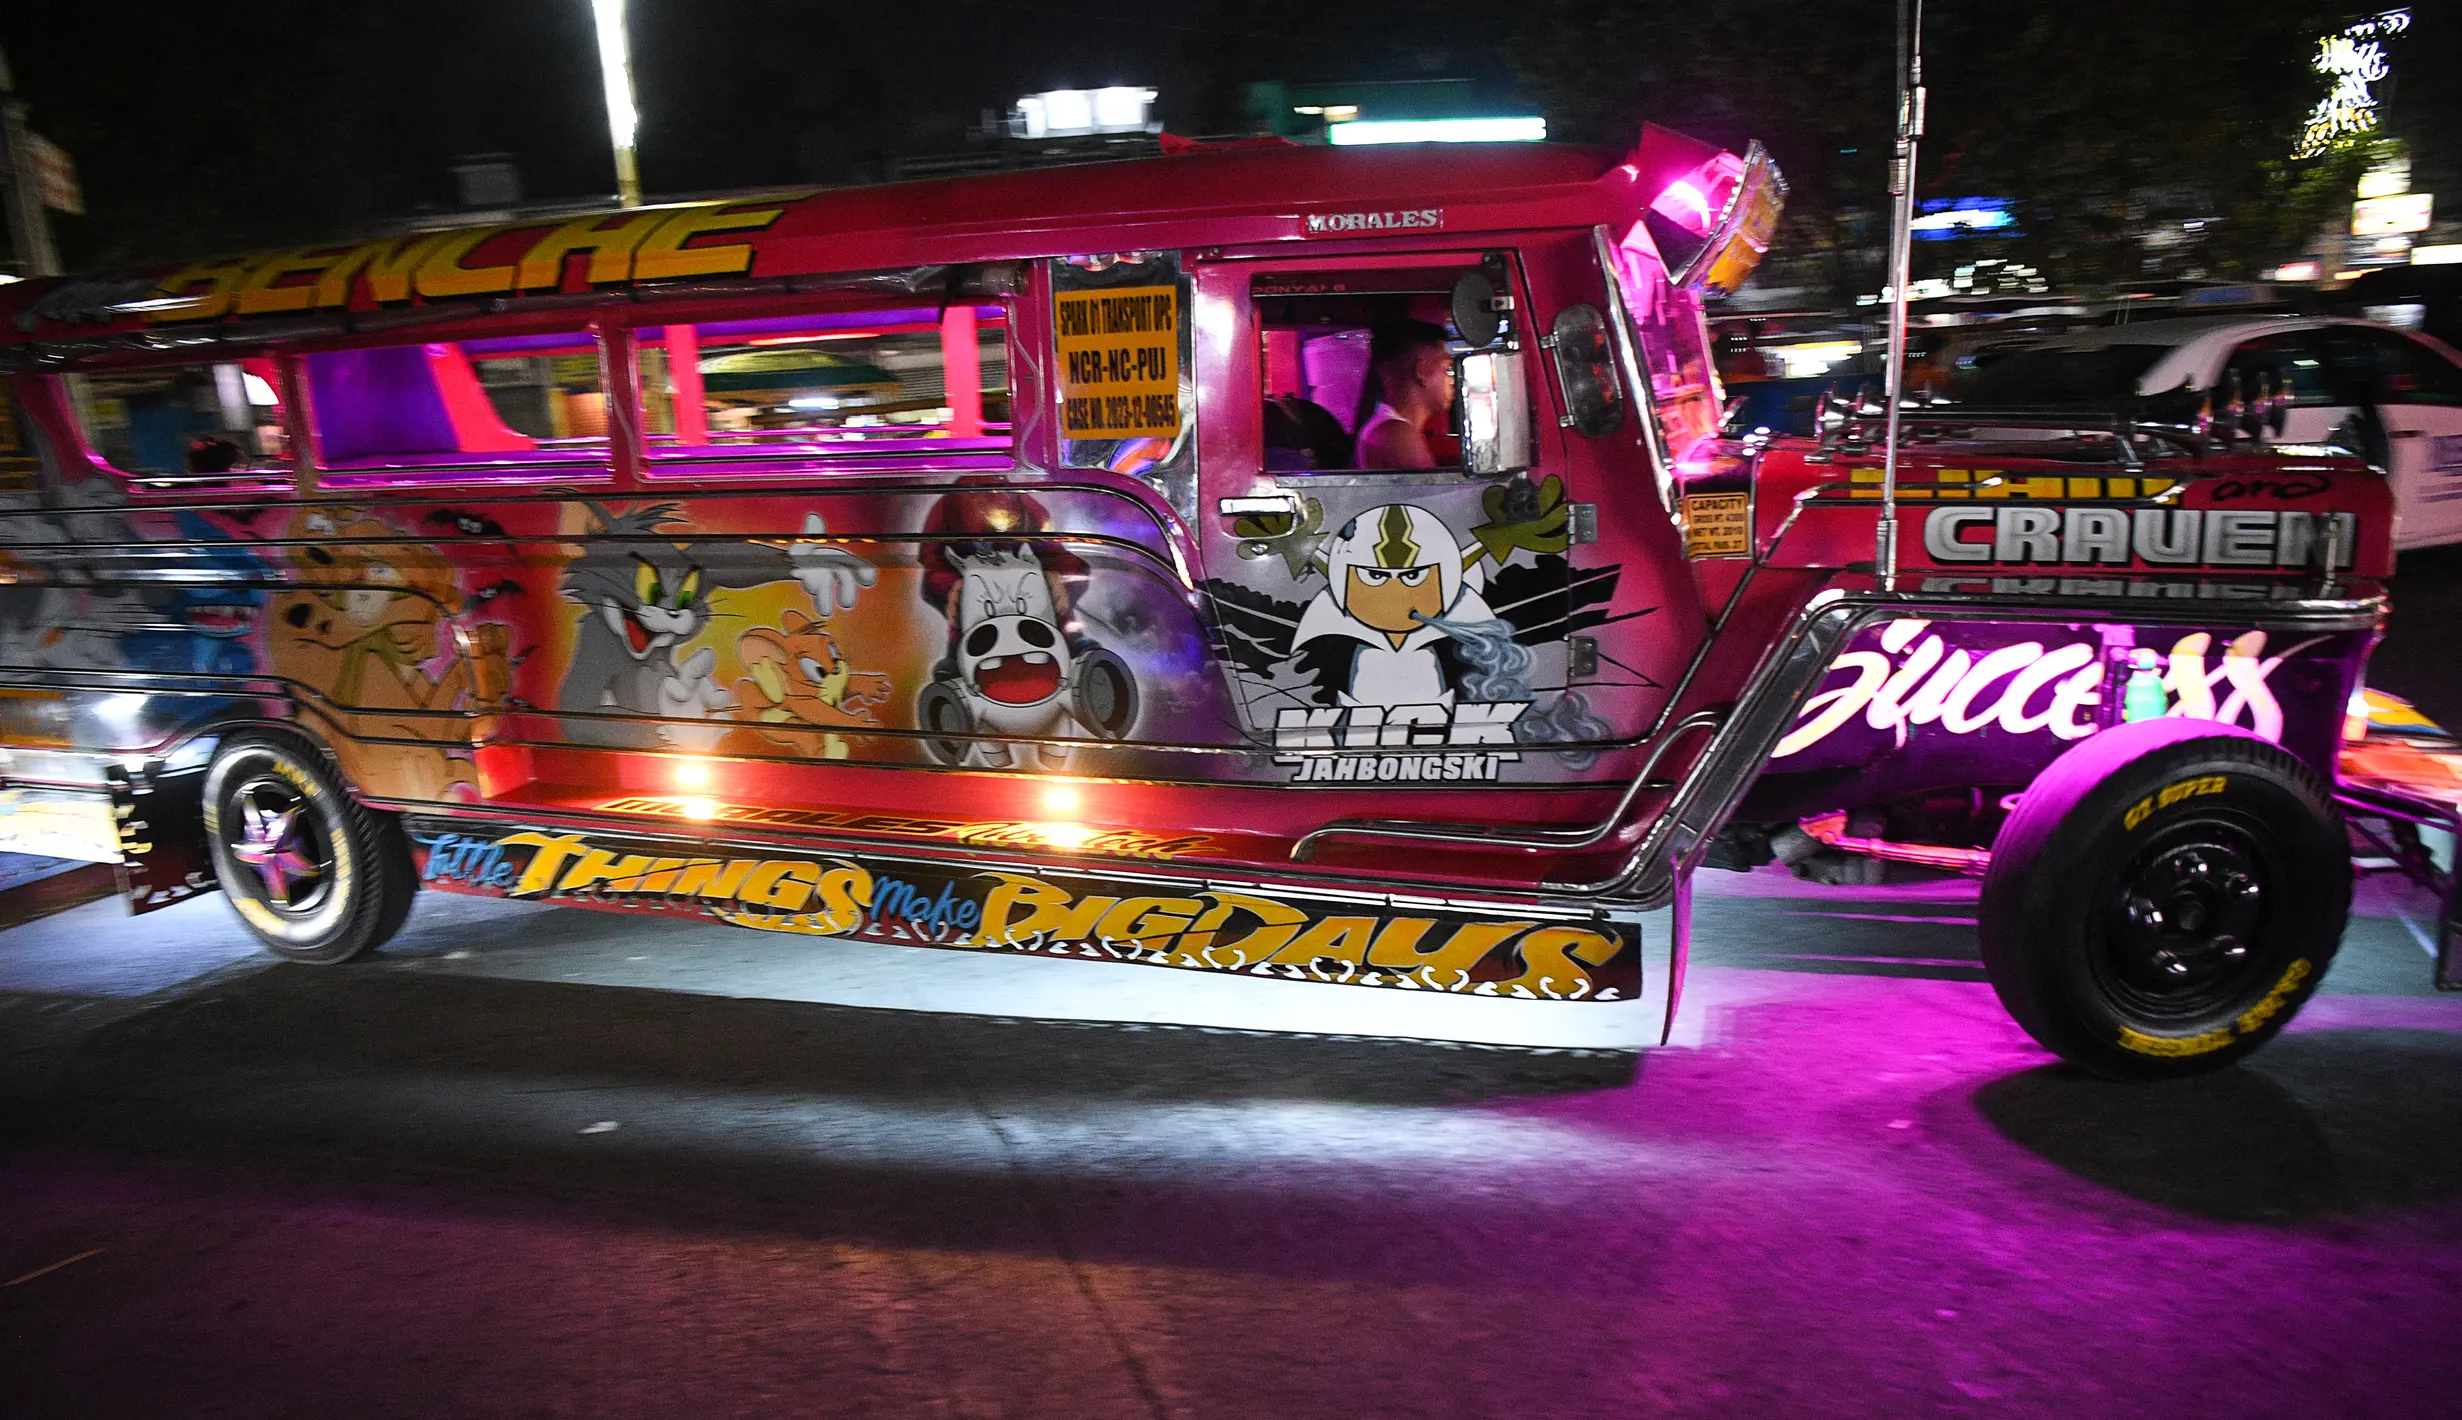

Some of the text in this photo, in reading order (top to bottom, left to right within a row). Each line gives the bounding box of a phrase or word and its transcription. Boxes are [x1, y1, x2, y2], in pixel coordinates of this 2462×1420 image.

[1307, 209, 1437, 232] MORALES
[1101, 295, 1152, 334] TRANSPORT
[1069, 347, 1166, 384] NCR-NC-PUJ
[2211, 472, 2331, 501] and
[1692, 498, 1742, 510] CAPACITY
[1274, 702, 1534, 760] KICK
[1293, 756, 1499, 781] JAHBONGSKI
[490, 832, 873, 936] THINGS
